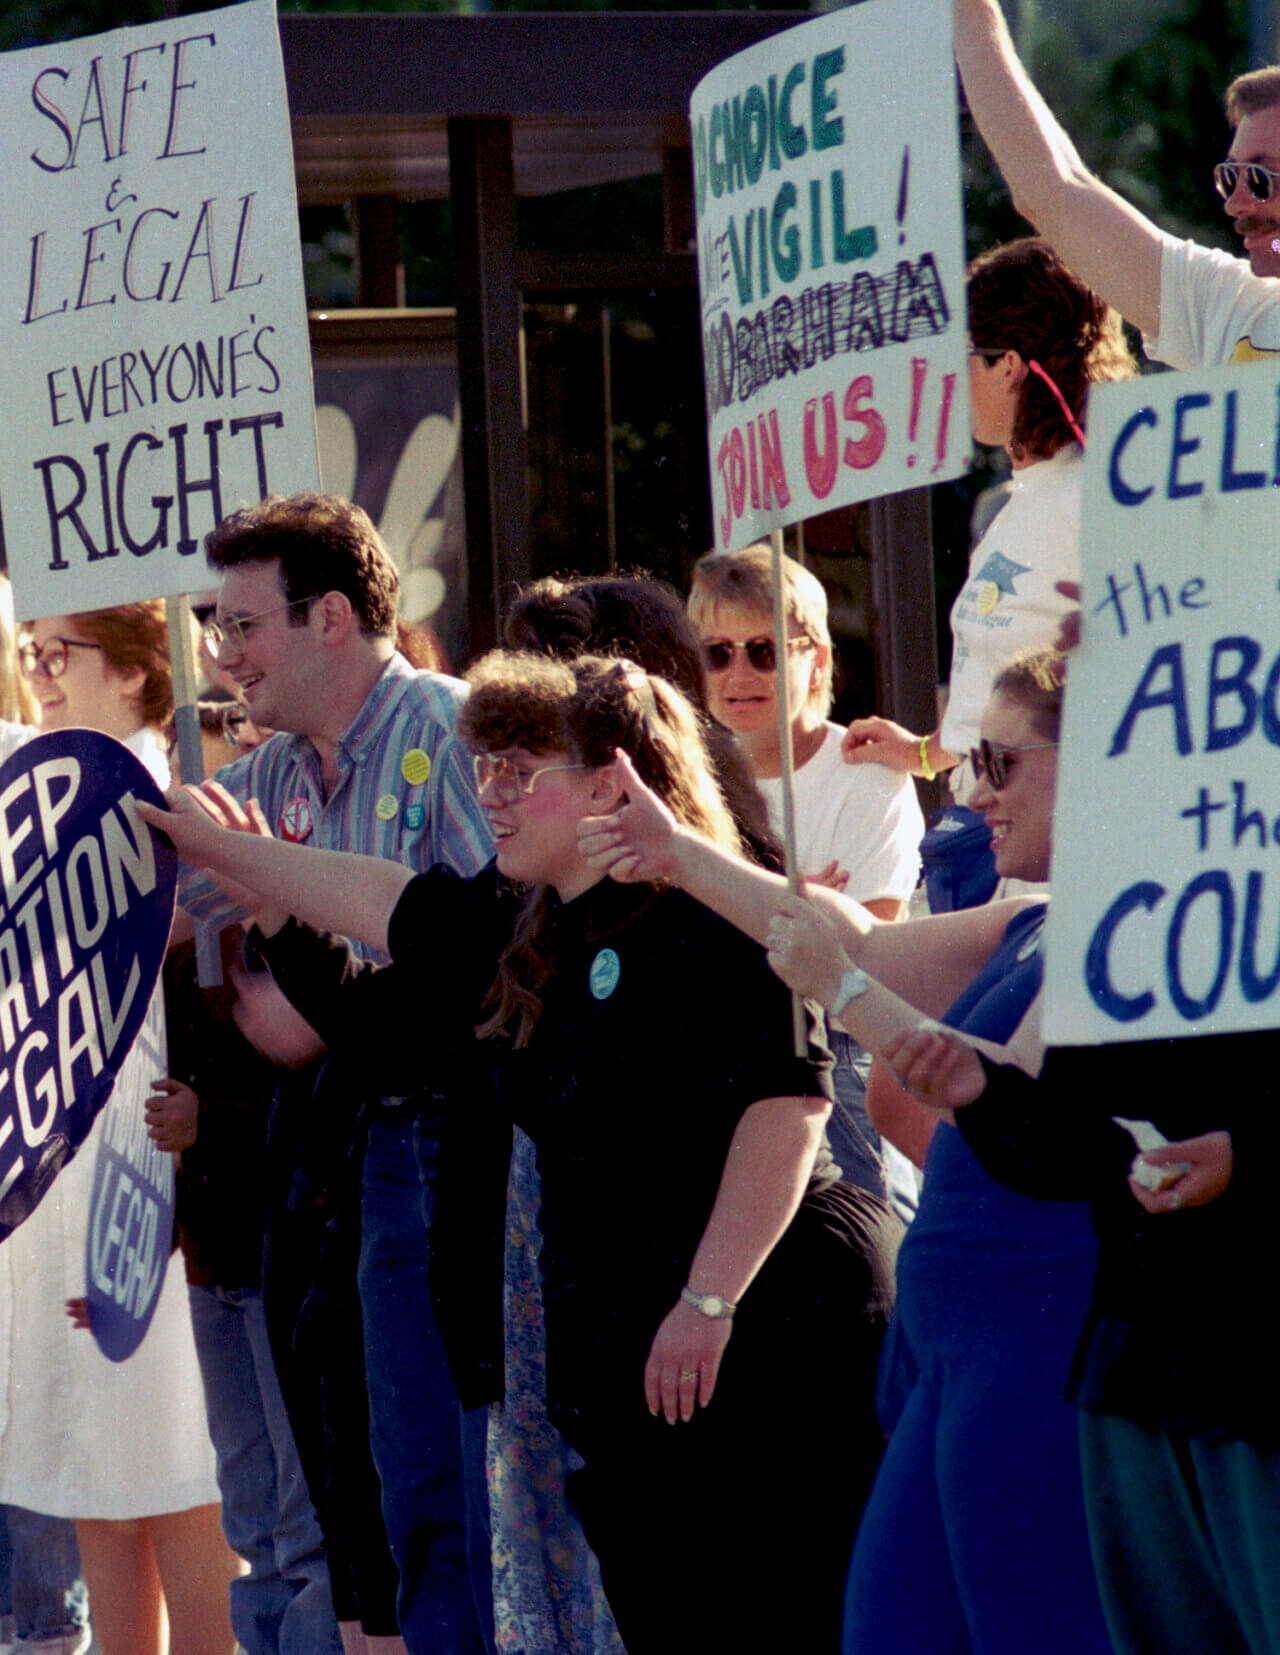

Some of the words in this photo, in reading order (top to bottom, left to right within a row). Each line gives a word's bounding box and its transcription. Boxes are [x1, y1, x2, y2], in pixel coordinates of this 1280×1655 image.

[31, 33, 216, 172] SAFE
[21, 192, 264, 324] LEGAL
[47, 314, 280, 427] EVERYONE'S
[33, 412, 283, 570] RIGHT
[717, 409, 791, 549] JOIN
[1108, 382, 1280, 507] CEL
[1094, 562, 1212, 637] the
[1180, 780, 1280, 852] th
[91, 1160, 161, 1319] LEGAL
